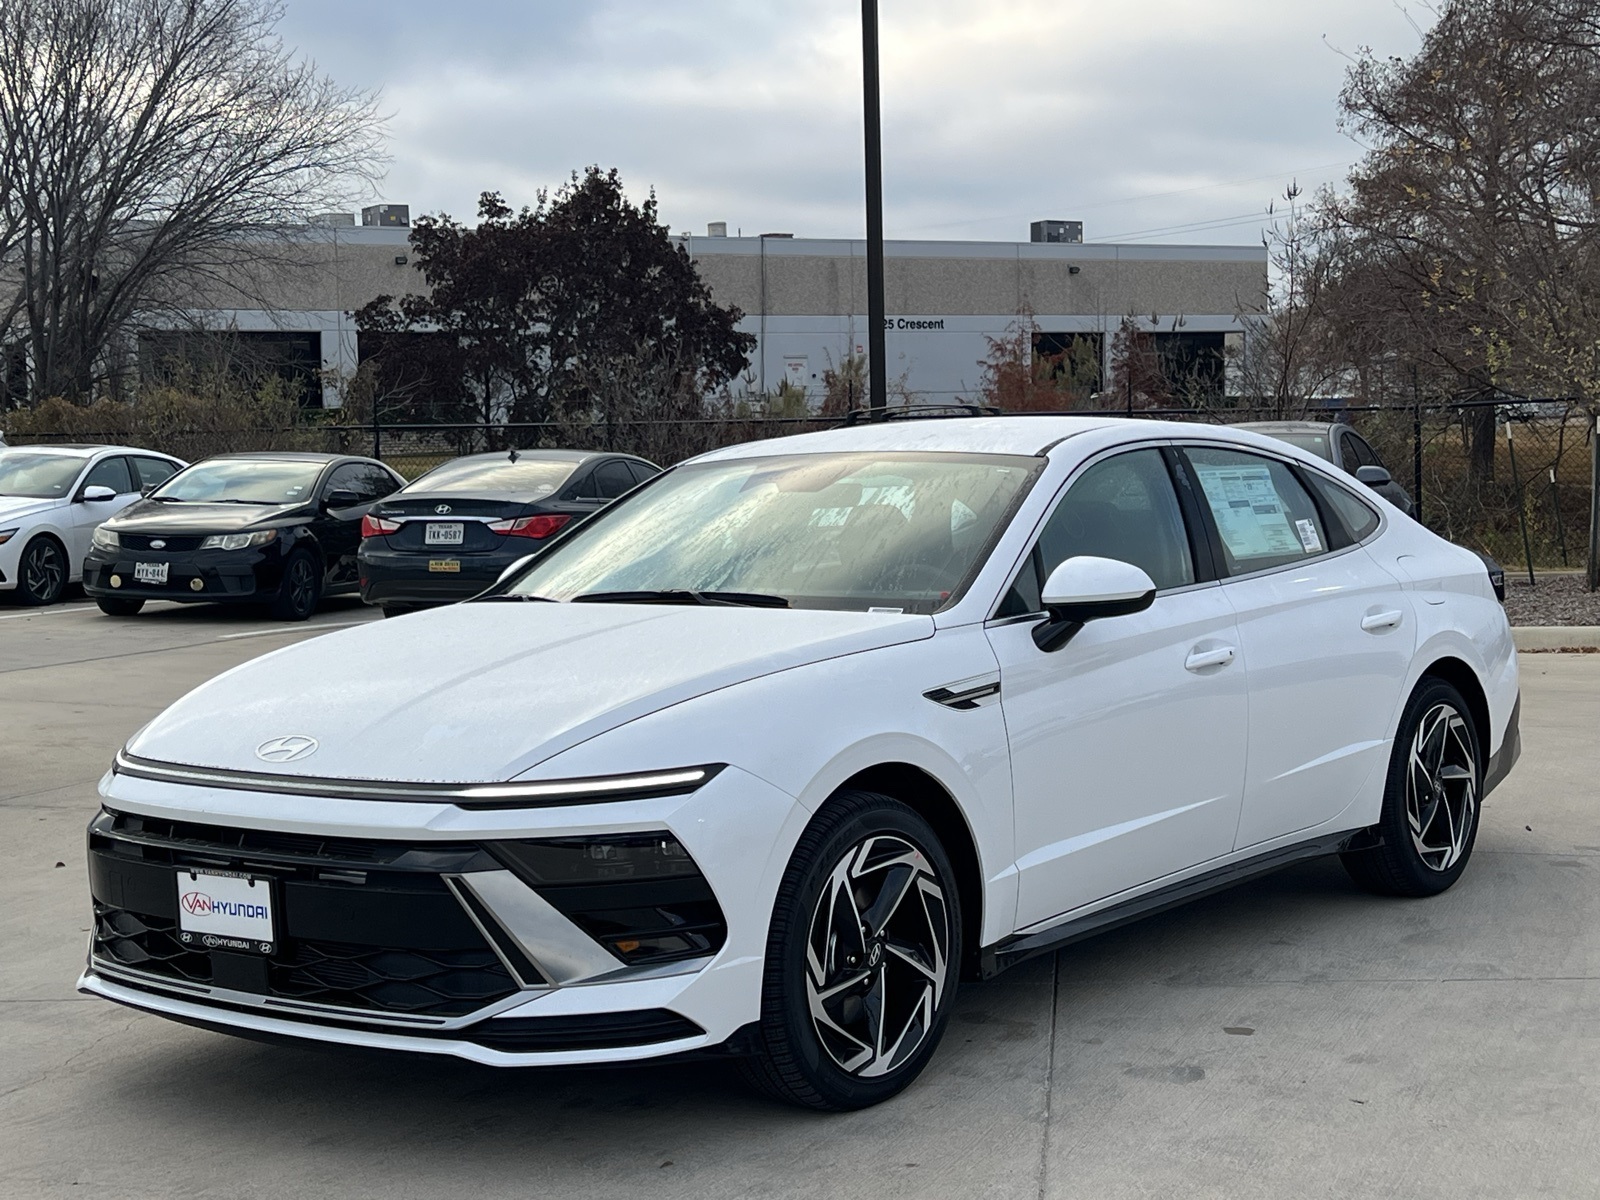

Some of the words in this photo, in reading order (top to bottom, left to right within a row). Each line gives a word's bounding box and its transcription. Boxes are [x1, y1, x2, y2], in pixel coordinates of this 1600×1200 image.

[897, 318, 944, 329] Crescent
[211, 901, 268, 919] HYUNDAI
[217, 938, 249, 949] HYUNDAI
